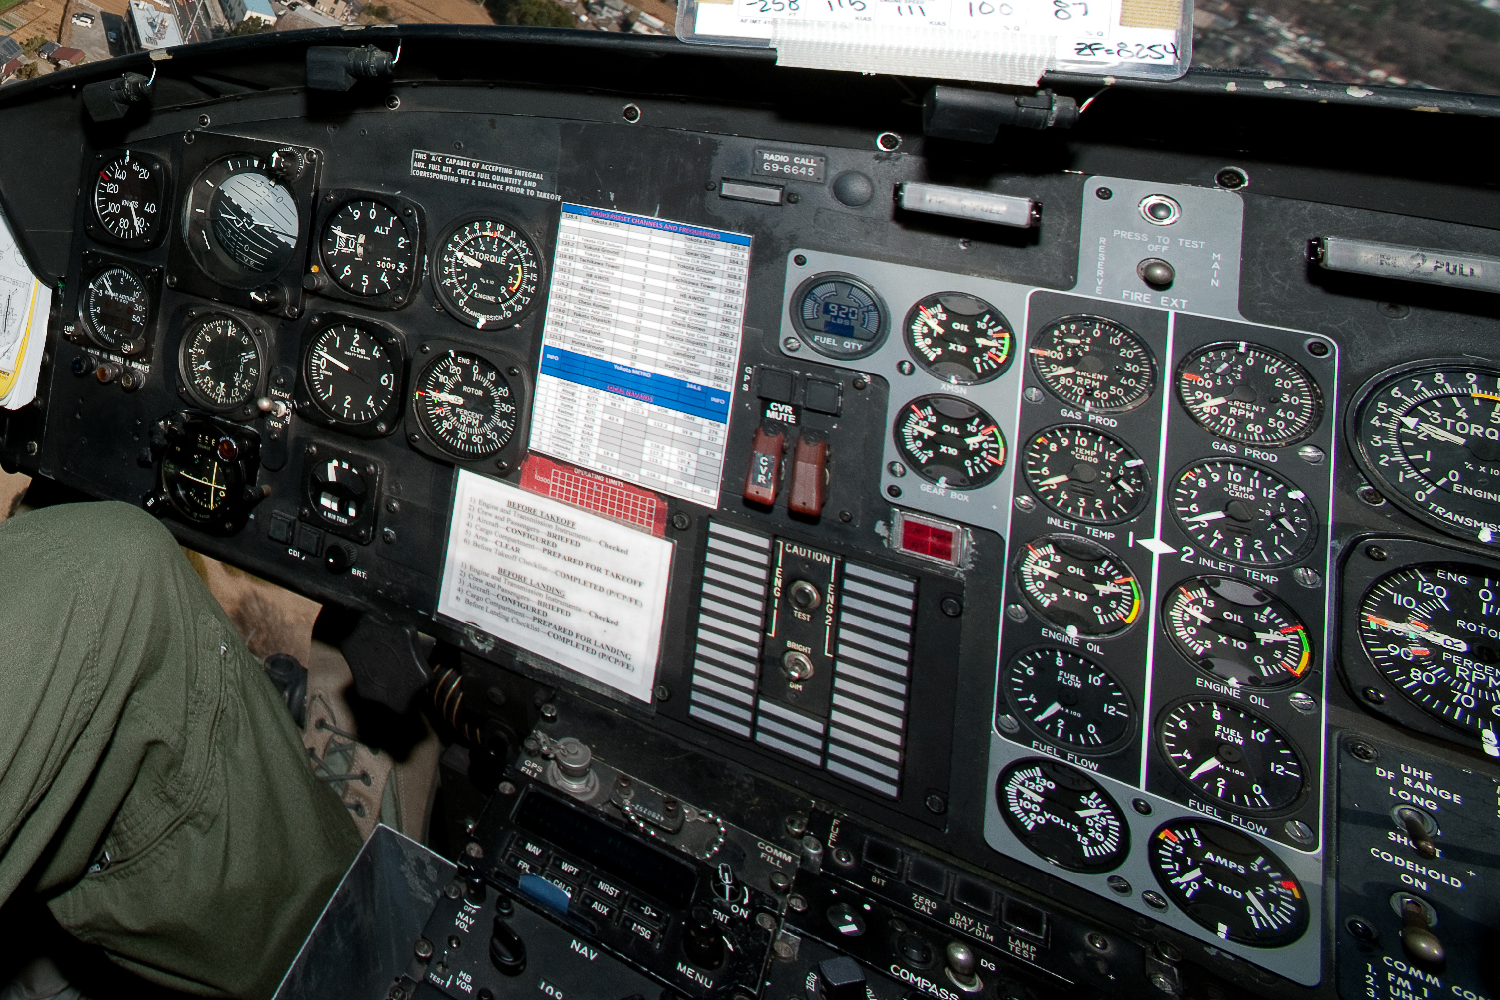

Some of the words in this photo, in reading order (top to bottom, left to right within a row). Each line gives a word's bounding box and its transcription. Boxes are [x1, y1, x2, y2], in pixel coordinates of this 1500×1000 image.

[968, 1, 1014, 17] 100
[414, 152, 427, 161] THIS
[430, 155, 443, 163] A/C
[445, 157, 471, 168] CAPABLE
[471, 161, 480, 170] OF
[480, 163, 513, 175] ACCEPTING
[514, 169, 544, 181] INTEGRAL
[763, 153, 790, 163] RADIO
[793, 156, 817, 167] CALL
[763, 162, 815, 177] 69-6645
[412, 169, 459, 183] CORRESPONDING
[460, 177, 470, 185] WT
[477, 180, 504, 191] BALANCE
[505, 185, 525, 195] PRIOR
[526, 188, 535, 197] TO
[536, 190, 562, 202] TAKEOFF
[428, 163, 442, 172] FUEL
[456, 168, 476, 178] CHECK
[477, 171, 491, 181] FUEL
[491, 174, 521, 186] QUANTITY
[523, 179, 537, 188] AND
[373, 225, 391, 236] ALT
[1113, 229, 1148, 242] PRESS
[1156, 235, 1170, 245] TO
[1178, 238, 1206, 249] TEST
[473, 251, 507, 266] TORQUE
[1147, 244, 1170, 253] OFF
[1095, 236, 1107, 295] RESERVE
[1210, 253, 1222, 287] MAIN
[1122, 290, 1152, 304] FIRE
[1160, 296, 1188, 310] EXT
[827, 303, 859, 320] 920
[951, 321, 970, 333] OIL
[349, 346, 366, 356] CLIMB
[814, 334, 838, 347] FUEL
[842, 340, 864, 351] QTY
[741, 366, 753, 392] GPS
[940, 383, 968, 395] XMSN
[270, 388, 290, 399] TACAN
[462, 385, 483, 397] ROTOR
[455, 407, 484, 421] PERCENT
[766, 409, 796, 425] MUTE
[769, 401, 793, 416] CVR
[1060, 409, 1082, 421] GAS
[1088, 414, 1118, 428] PROD
[459, 415, 480, 428] RPM
[1211, 441, 1237, 454] GAS
[1244, 447, 1278, 463] PROD
[757, 456, 769, 485] CVR
[920, 483, 946, 497] GEAR
[950, 489, 969, 501] BOX
[506, 499, 538, 517] BEFORE
[540, 508, 577, 530] TAKEOFF
[1047, 516, 1078, 532] INLET
[1085, 526, 1116, 541] TEMP
[784, 543, 831, 565] CAUTION
[585, 560, 603, 573] FOR
[604, 565, 644, 588] TAKEOFF
[1198, 556, 1235, 574] INLET
[1244, 568, 1280, 585] TEMP
[497, 566, 529, 584] BEFORE
[529, 577, 566, 599] LANDING
[1416, 579, 1448, 600] 120
[793, 610, 812, 622] TEST
[574, 632, 592, 647] FOR
[593, 638, 632, 661] LANDING
[786, 640, 812, 655] BRIGHT
[1041, 628, 1080, 648] ENGINE
[1086, 642, 1105, 656] OIL
[1195, 677, 1242, 700] ENGINE
[1248, 694, 1270, 709] OIL
[1031, 740, 1062, 758] FUEL
[1067, 752, 1099, 772] FLOW
[1400, 763, 1433, 782] UHF
[1375, 766, 1396, 781] DF
[1403, 776, 1463, 805] RANGE
[1389, 786, 1439, 812] LONG
[1043, 811, 1080, 833] VOLTS
[1188, 798, 1222, 820] FUEL
[1230, 814, 1268, 836] FLOW
[525, 842, 543, 857] NAV
[757, 841, 793, 863] COMM
[1387, 830, 1442, 859] SHT
[560, 862, 580, 877] WPT
[760, 851, 783, 869] FILL
[1204, 851, 1246, 875] AMPS
[1369, 847, 1463, 889] CODEHOLD
[597, 880, 620, 899] NRST
[1400, 873, 1428, 891] ON
[591, 900, 611, 917] AUX
[911, 893, 938, 910] ZERO
[913, 901, 934, 916] CAL
[631, 922, 652, 941] MSG
[949, 917, 995, 943] BRT/DIM
[570, 939, 598, 962] NAV
[1008, 935, 1038, 953] LAMP
[1008, 943, 1037, 962] TEST
[676, 962, 714, 990] MENU
[1382, 955, 1441, 988] COMM
[889, 964, 960, 1000] COMPASS
